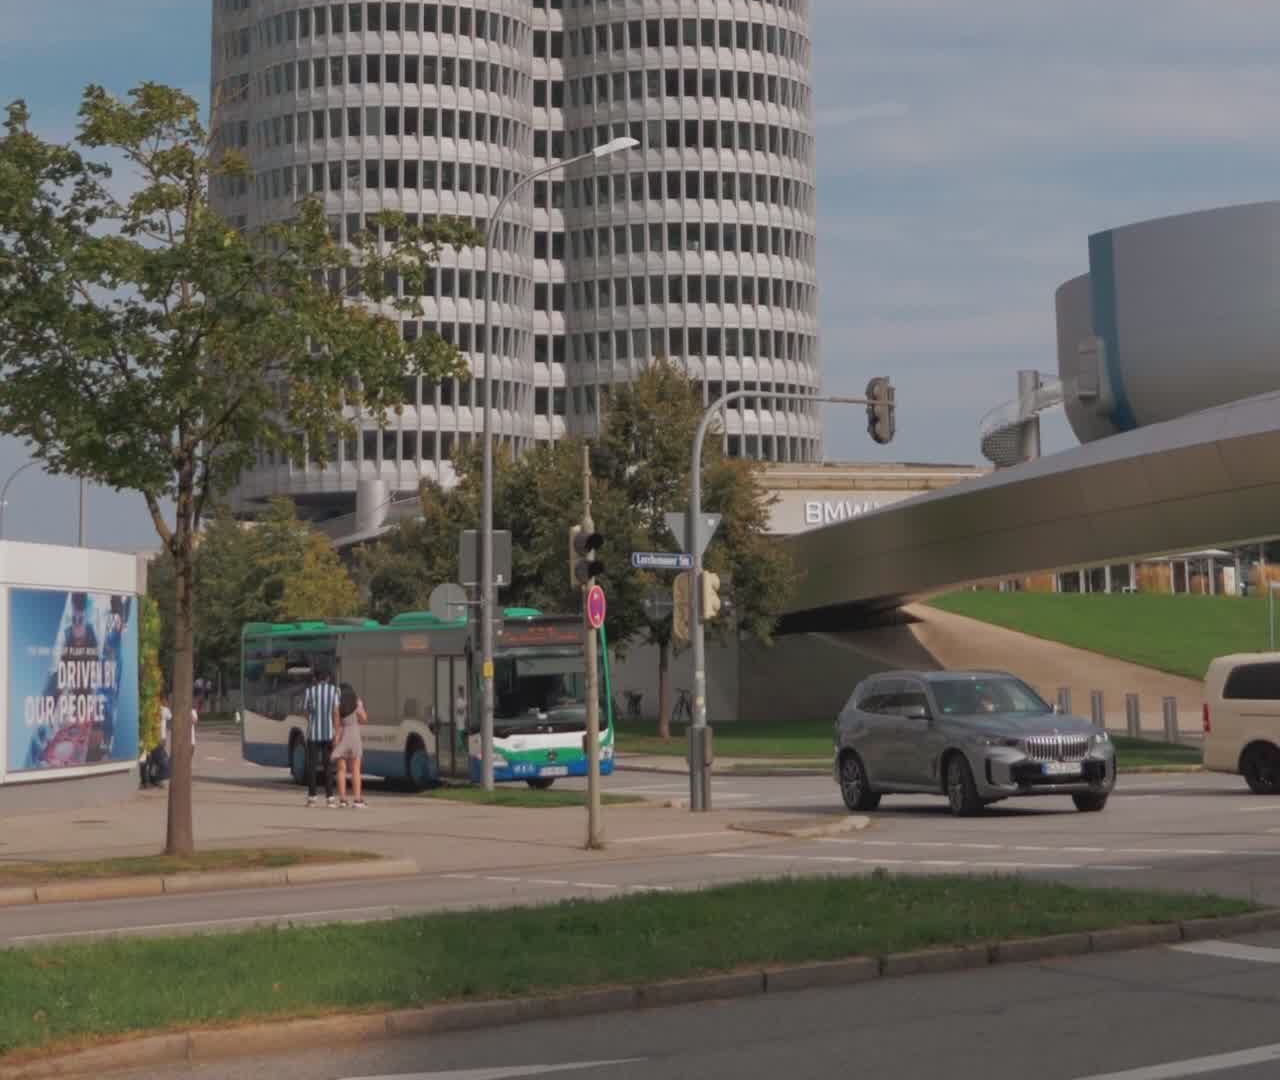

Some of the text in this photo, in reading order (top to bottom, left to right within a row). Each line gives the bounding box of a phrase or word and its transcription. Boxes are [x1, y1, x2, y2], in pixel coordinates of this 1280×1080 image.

[57, 660, 117, 690] DRIVEN BY
[23, 694, 105, 728] OUR PEOPLE
